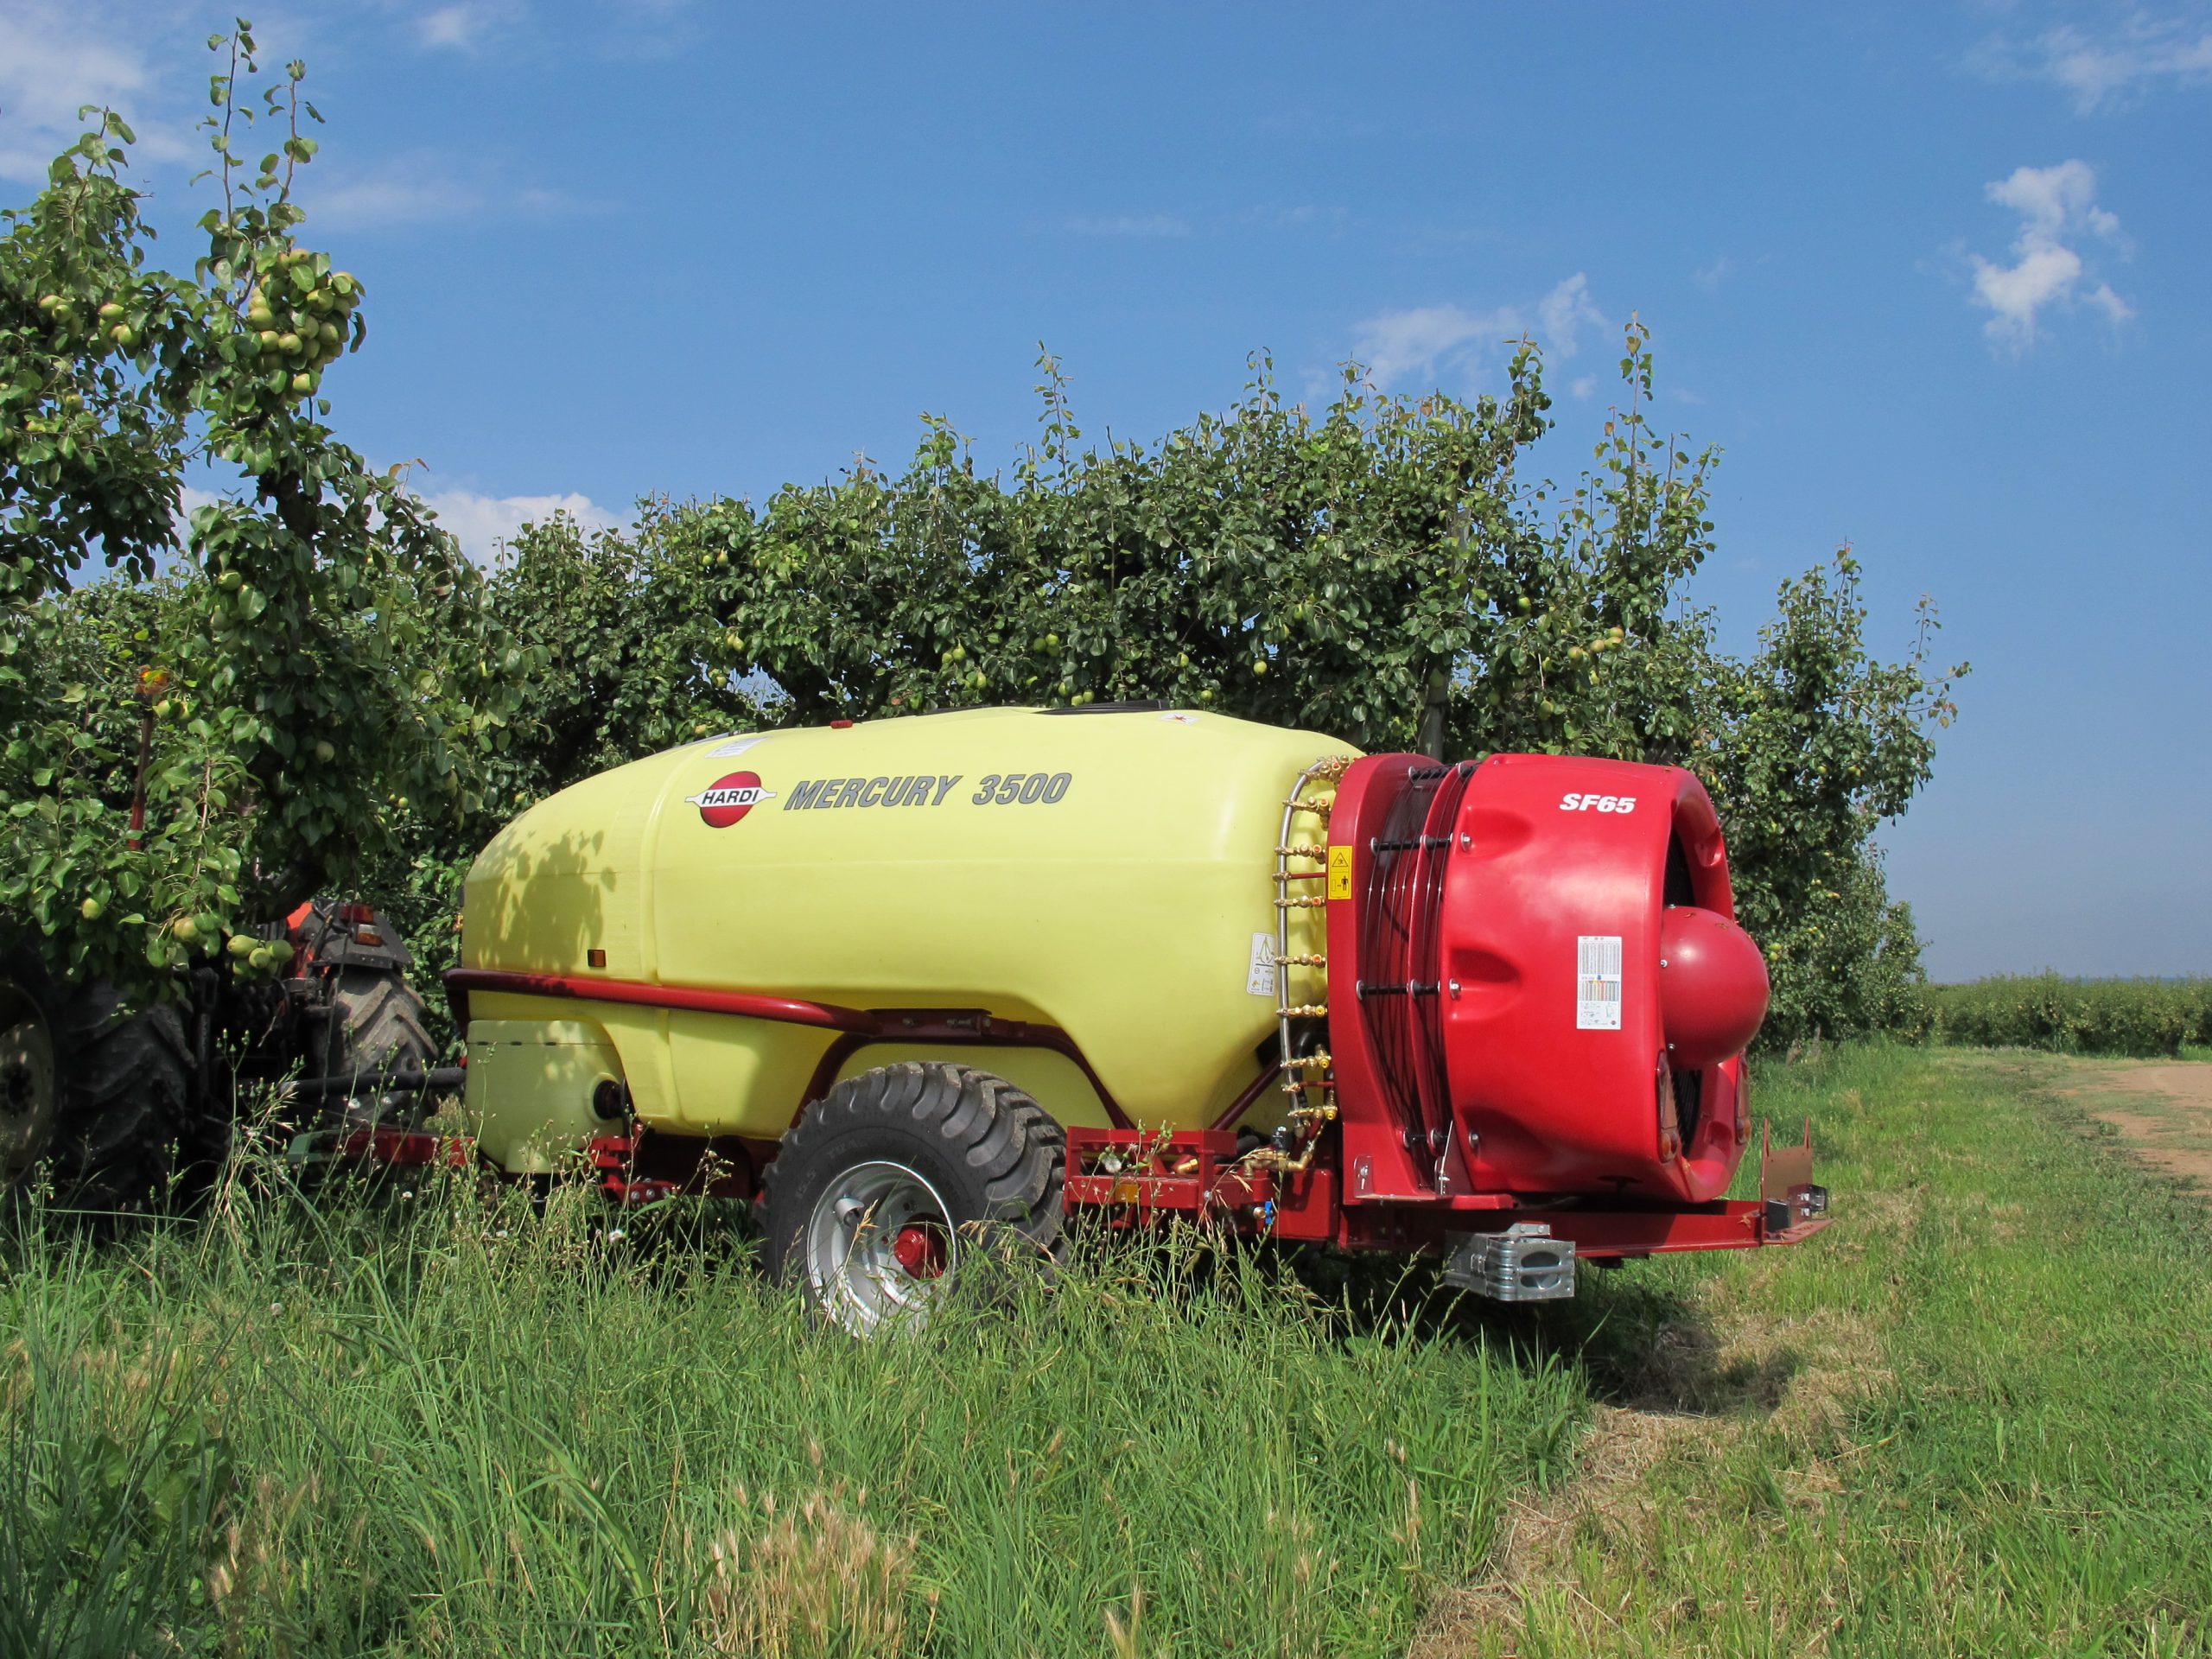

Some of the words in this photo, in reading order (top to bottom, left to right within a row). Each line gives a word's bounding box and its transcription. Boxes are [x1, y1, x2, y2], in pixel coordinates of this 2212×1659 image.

[702, 789, 760, 804] HARDI
[783, 775, 963, 810] MERCURY
[972, 772, 1072, 804] 3500
[1560, 793, 1637, 813] SF65
